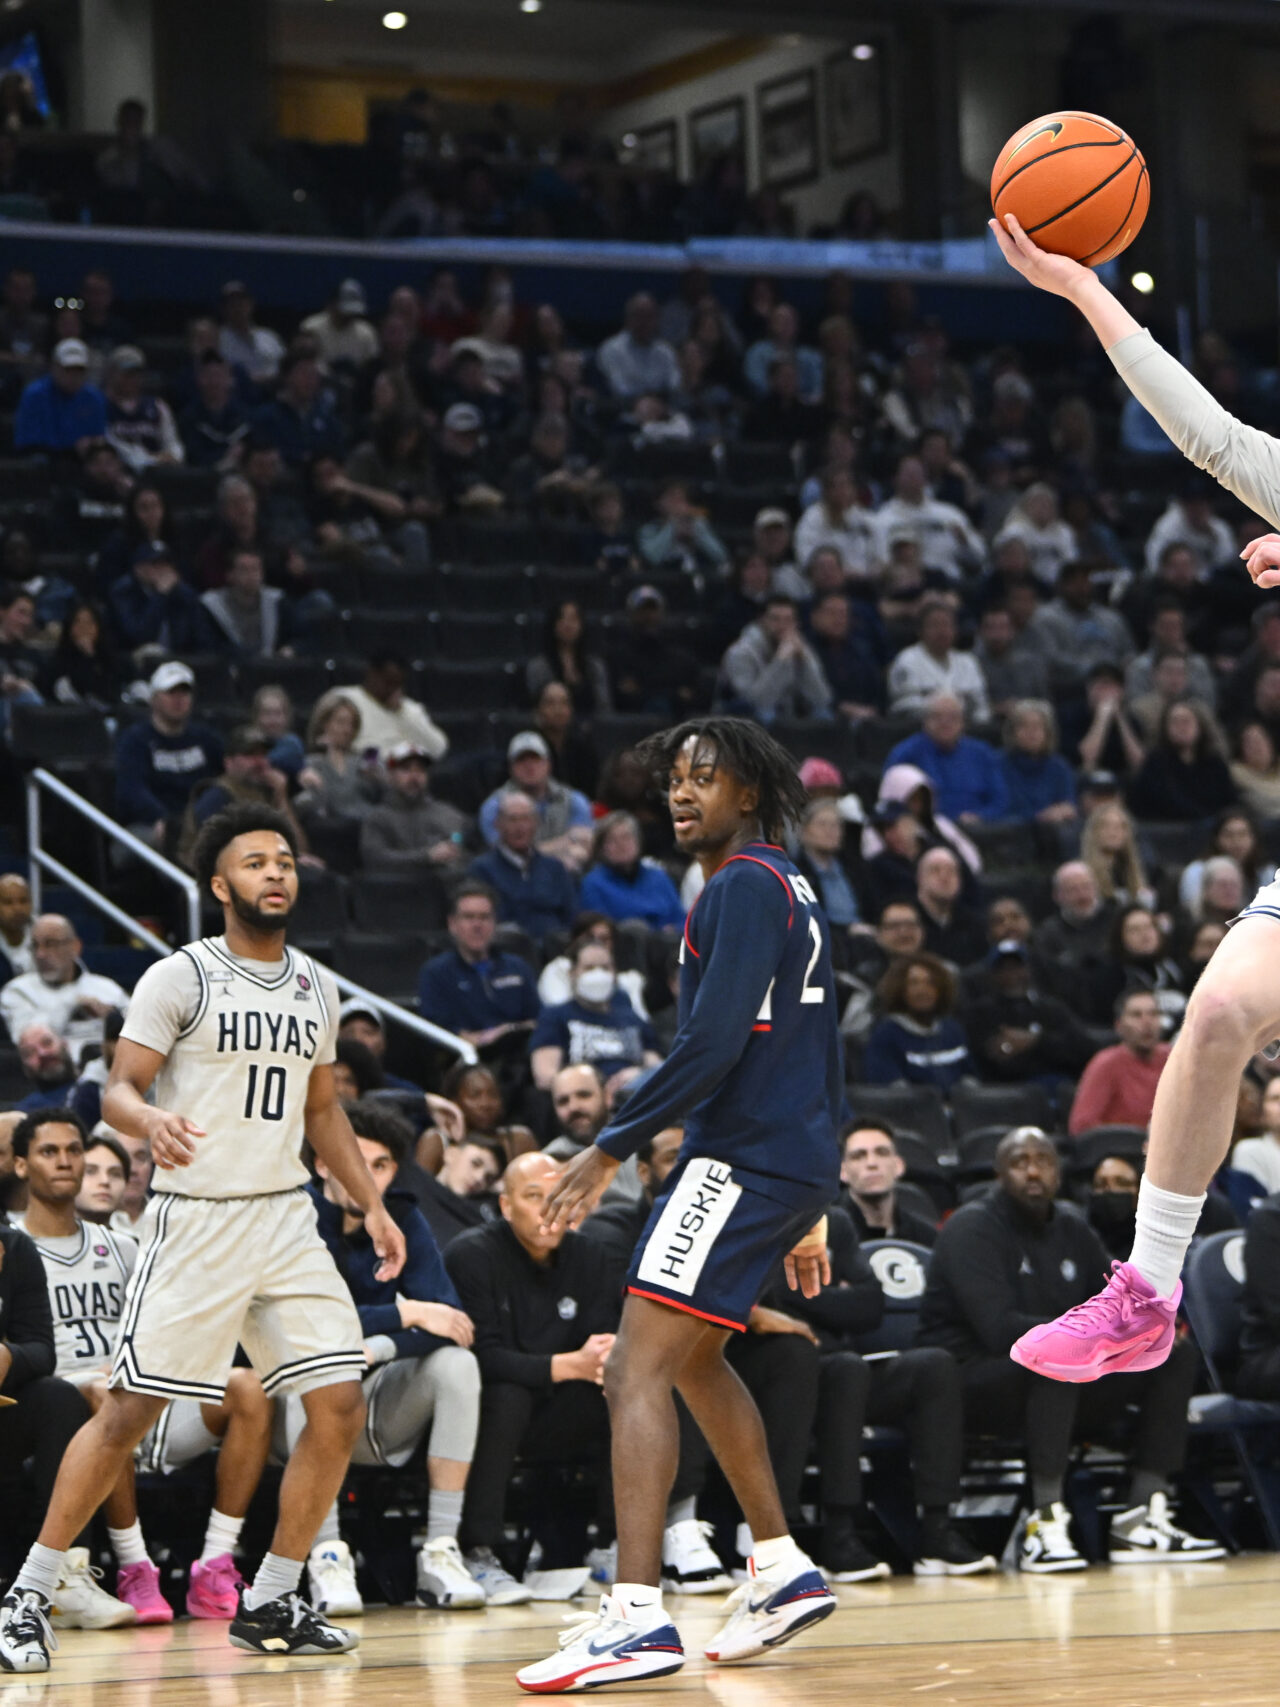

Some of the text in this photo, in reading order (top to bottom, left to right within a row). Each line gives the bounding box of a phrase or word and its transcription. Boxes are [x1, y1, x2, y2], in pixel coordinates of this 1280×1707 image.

[800, 916, 825, 1003] 2
[217, 1011, 318, 1060] HOYAS
[244, 1064, 287, 1121] 10
[659, 1163, 733, 1279] HUSKIE
[54, 1281, 121, 1319] OYAS
[64, 1318, 110, 1359] 31
